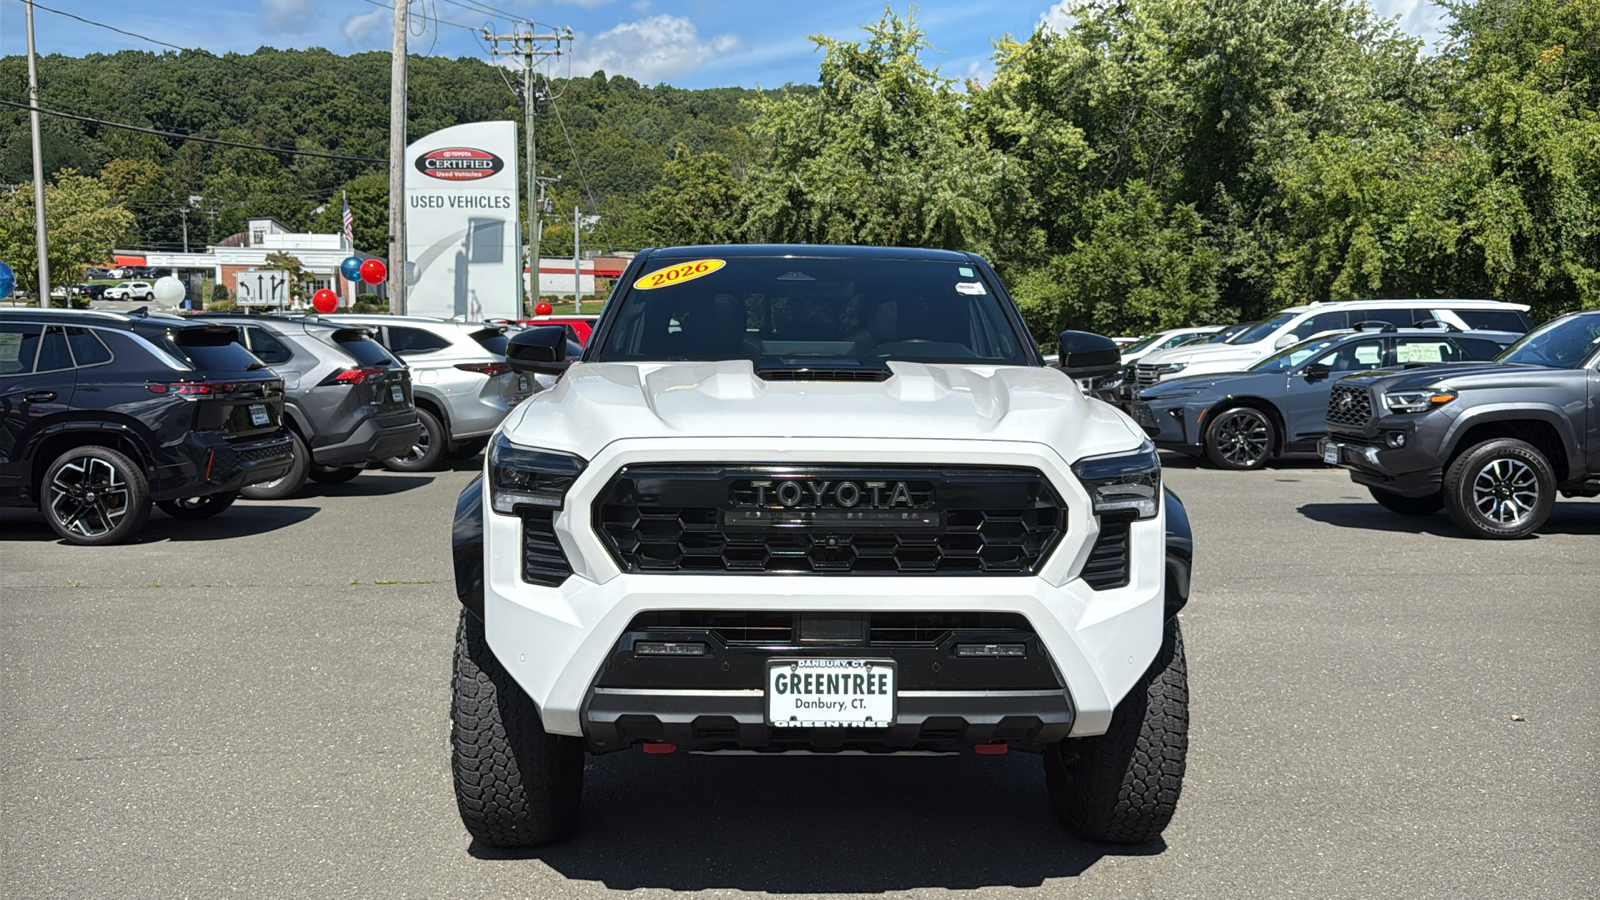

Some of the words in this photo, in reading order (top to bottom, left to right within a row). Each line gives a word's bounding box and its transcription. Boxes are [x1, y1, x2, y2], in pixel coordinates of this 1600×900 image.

[425, 158, 493, 169] CERTIFIED
[411, 195, 444, 208] USED
[448, 195, 511, 208] VEHICLES
[651, 262, 709, 286] 2026
[751, 481, 914, 508] TOYOTA
[798, 660, 849, 669] DANBURY,
[775, 673, 888, 695] GREENTREE
[795, 698, 847, 712] Danbury,
[851, 698, 867, 710] CT.
[774, 720, 889, 728] GREENTREE
